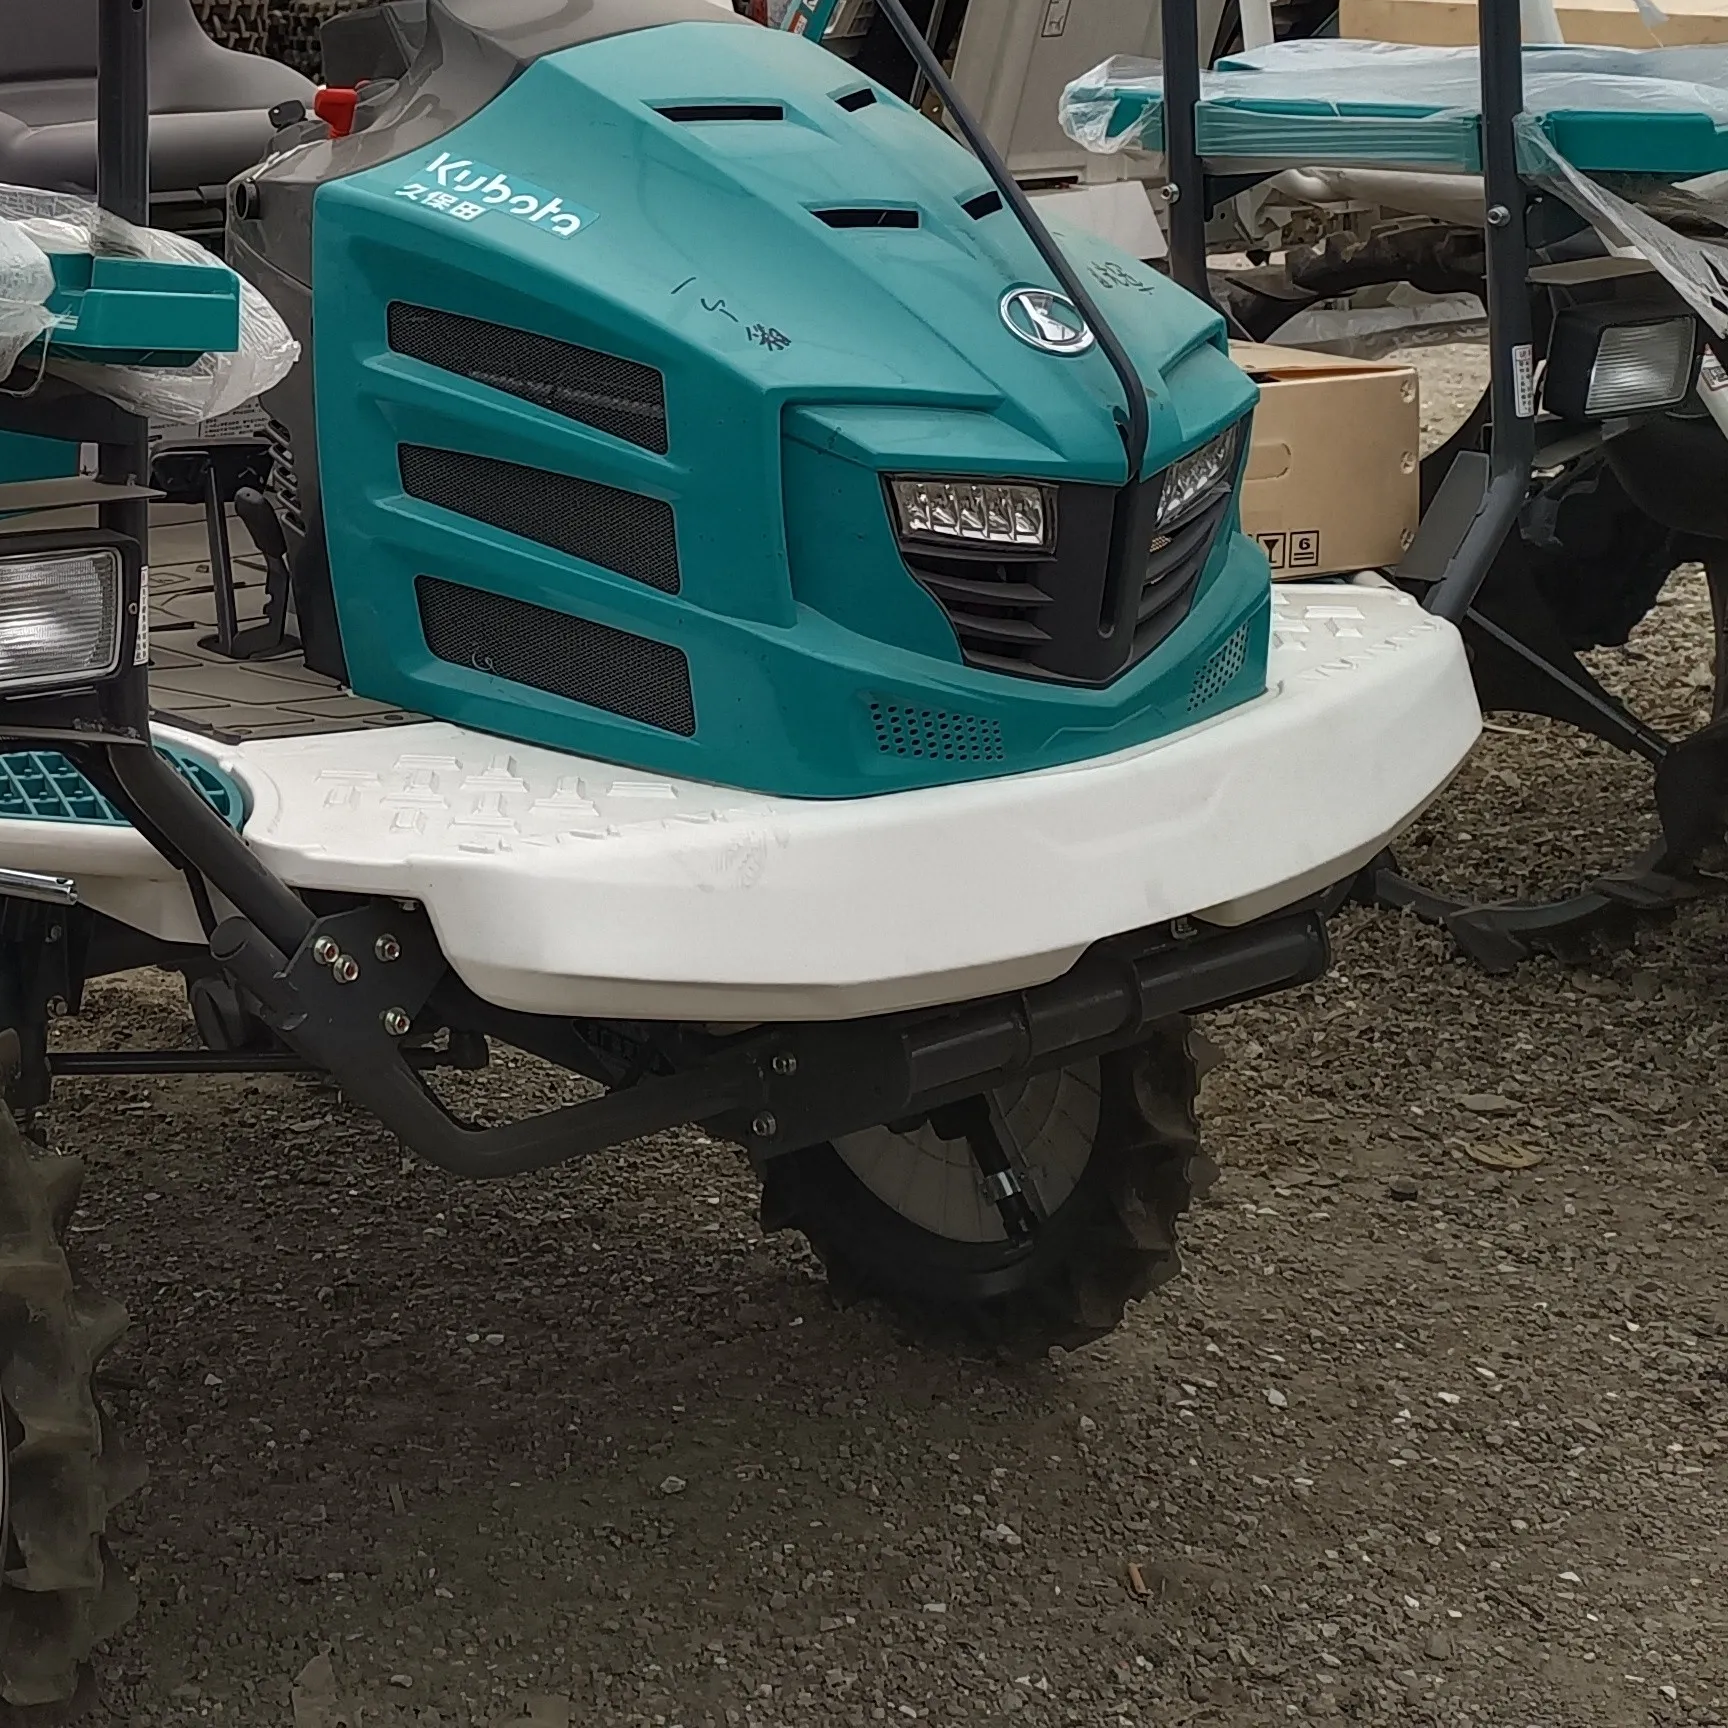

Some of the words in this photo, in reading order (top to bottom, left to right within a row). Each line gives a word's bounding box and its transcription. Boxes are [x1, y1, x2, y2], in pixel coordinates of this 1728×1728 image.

[395, 183, 486, 221] 久保田
[426, 152, 581, 236] Kubota
[1298, 537, 1311, 550] 6
